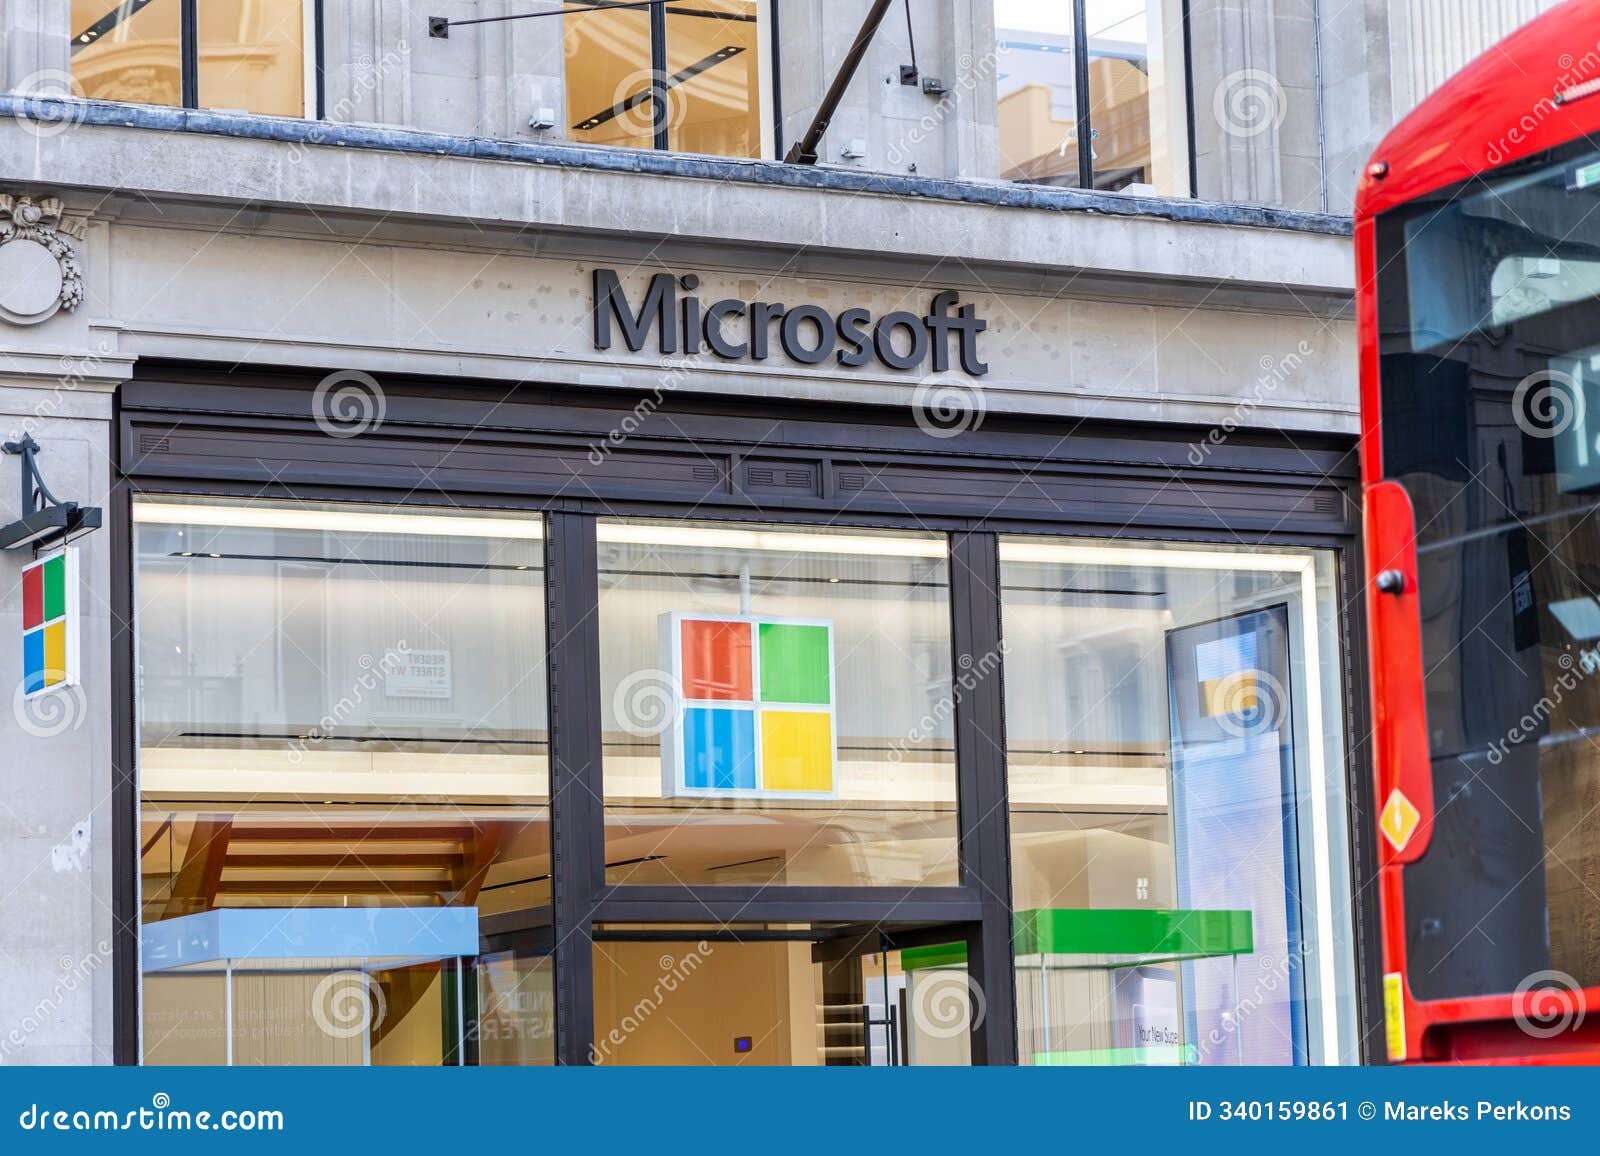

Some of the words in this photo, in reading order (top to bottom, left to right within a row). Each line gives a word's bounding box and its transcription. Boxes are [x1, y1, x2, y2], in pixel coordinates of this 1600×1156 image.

[592, 268, 988, 377] Microsoft
[1138, 1024, 1151, 1042] Your
[1152, 1025, 1164, 1043] New
